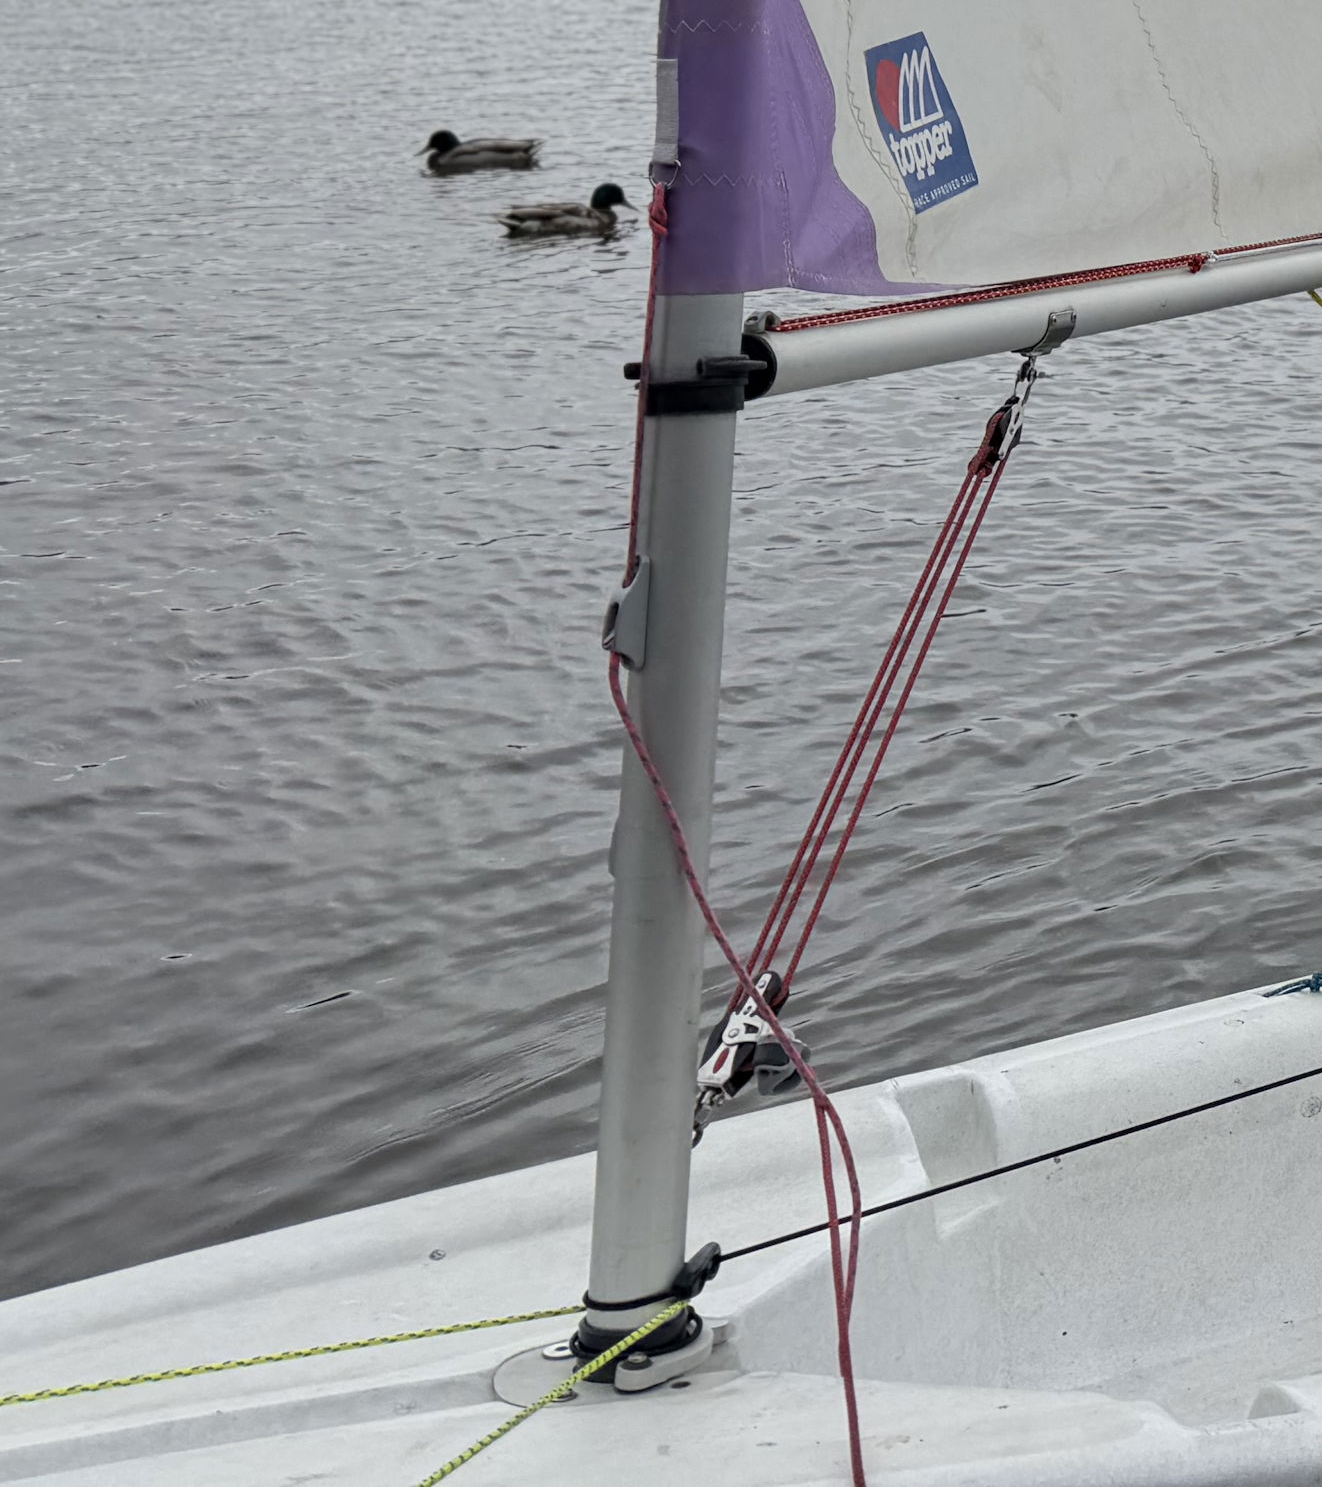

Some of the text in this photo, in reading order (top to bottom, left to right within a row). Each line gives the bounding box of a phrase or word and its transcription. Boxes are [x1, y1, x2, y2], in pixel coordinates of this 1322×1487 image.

[889, 120, 953, 181] topper
[914, 172, 977, 208] RACE APPROVED SAIL
